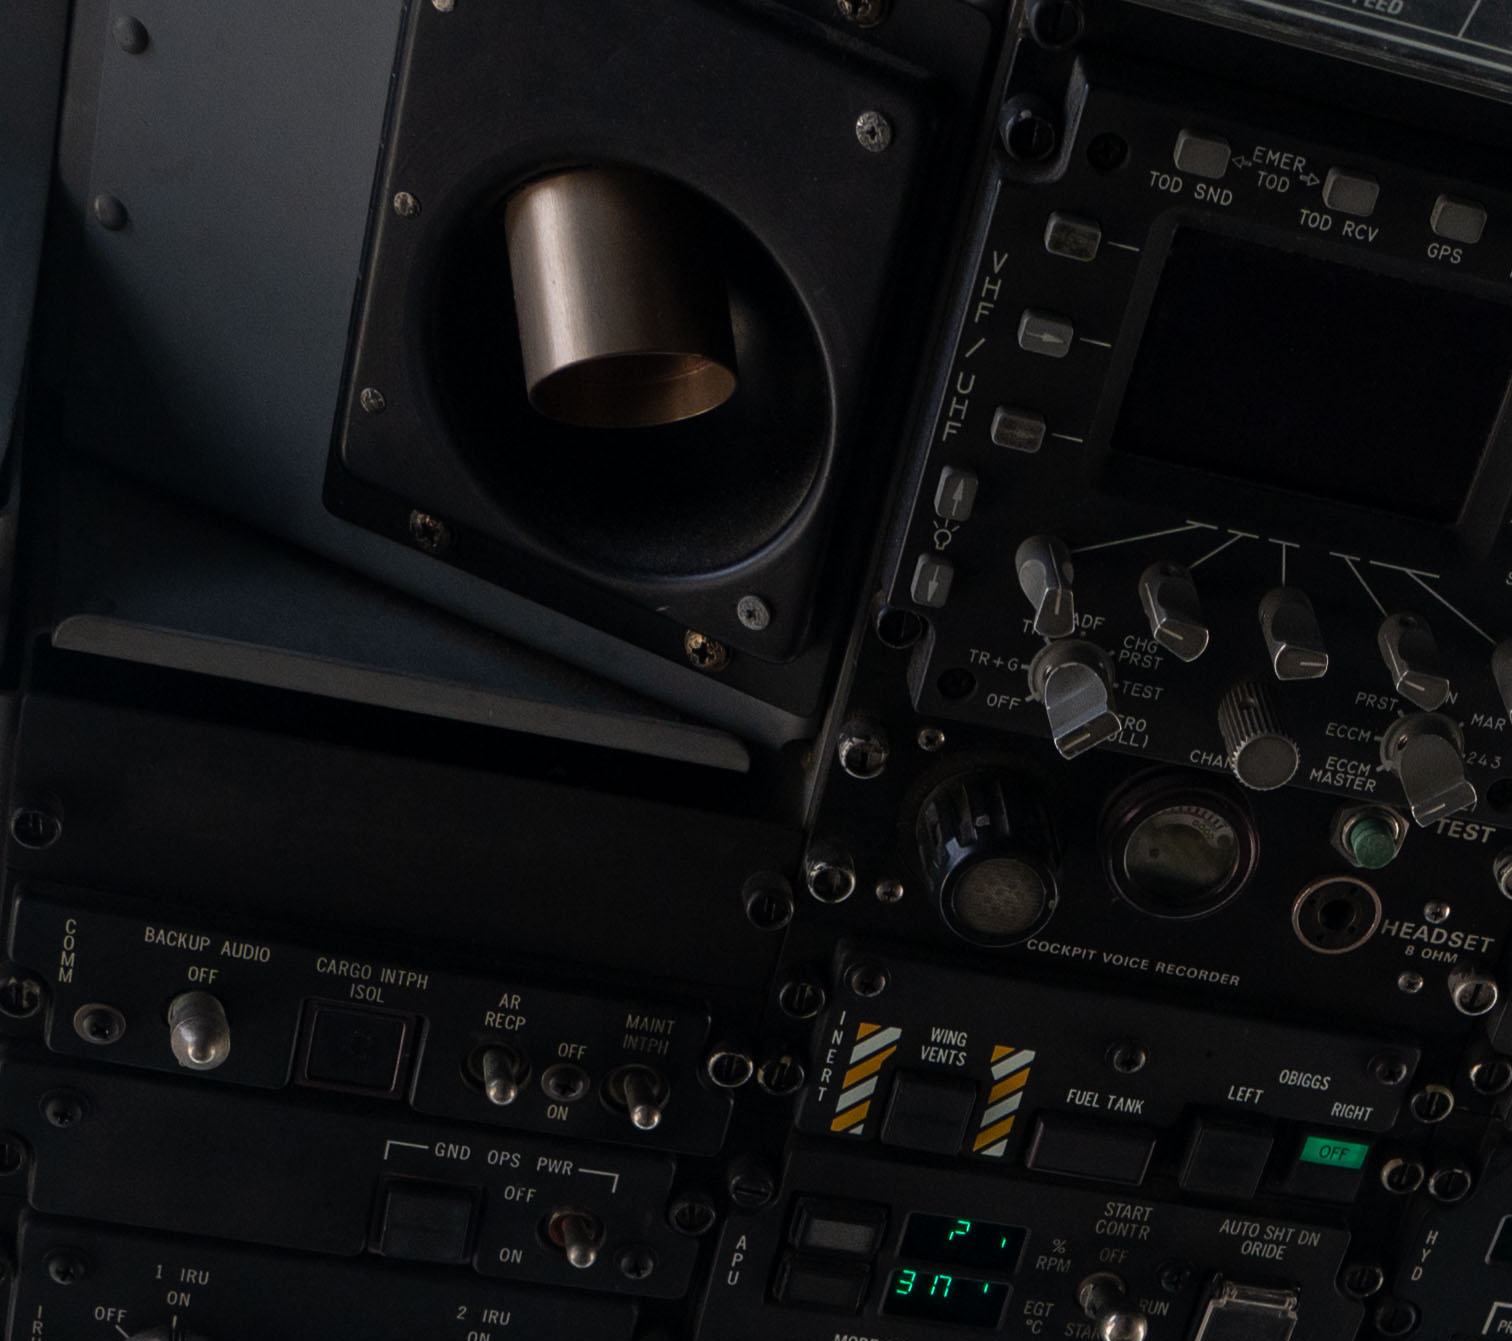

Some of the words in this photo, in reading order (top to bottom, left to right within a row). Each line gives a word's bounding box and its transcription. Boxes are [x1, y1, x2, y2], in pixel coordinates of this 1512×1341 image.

[1252, 144, 1308, 174] EMER
[1148, 171, 1188, 195] TOD
[1193, 183, 1234, 207] SND
[1255, 171, 1291, 194] TOD
[1298, 209, 1337, 233] TOD
[1341, 218, 1379, 244] RCV
[1427, 241, 1463, 265] GPS
[1123, 634, 1159, 655] CHG
[968, 646, 1019, 672] TR+G
[1118, 647, 1164, 671] PRST
[986, 691, 1021, 712] OFF
[1120, 680, 1166, 703] TEST
[1355, 689, 1399, 713] PRST
[1325, 722, 1373, 745] ECCM
[1471, 711, 1507, 732] MAR
[1325, 754, 1372, 776] ECCM
[1309, 767, 1377, 794] MASTER
[1435, 820, 1495, 845] TEST
[144, 926, 212, 952] BACKUP
[220, 940, 272, 964] AUDIO
[1381, 919, 1494, 954] HEADSET
[315, 956, 374, 983] CARGO
[379, 965, 429, 990] INTPH
[1026, 937, 1097, 965] COCKPIT
[1102, 950, 1152, 972] VOICE
[1156, 960, 1241, 987] RECORDER
[187, 966, 219, 985] OFF
[349, 982, 386, 1003] ISOL
[497, 993, 522, 1011] AR
[484, 1011, 526, 1032] RECP
[626, 1014, 676, 1037] MAINT
[929, 1026, 969, 1049] WING
[919, 1044, 967, 1067] VENTS
[1277, 1069, 1332, 1094] OBIGGS
[1066, 1088, 1106, 1111] FUEL
[1108, 1092, 1146, 1116] TANK
[1227, 1084, 1264, 1106] LEFT
[1330, 1099, 1375, 1124] RIGHT
[434, 1141, 472, 1161] GND
[487, 1149, 522, 1168] OPS
[536, 1156, 574, 1176] PWR
[504, 1185, 537, 1202] OFF
[1104, 1201, 1154, 1224] START
[1095, 1218, 1151, 1242] CONTR
[1218, 1218, 1263, 1242] AUTO
[1266, 1226, 1296, 1245] SHT
[1297, 1229, 1320, 1249] DN
[1240, 1238, 1287, 1261] ORIDE
